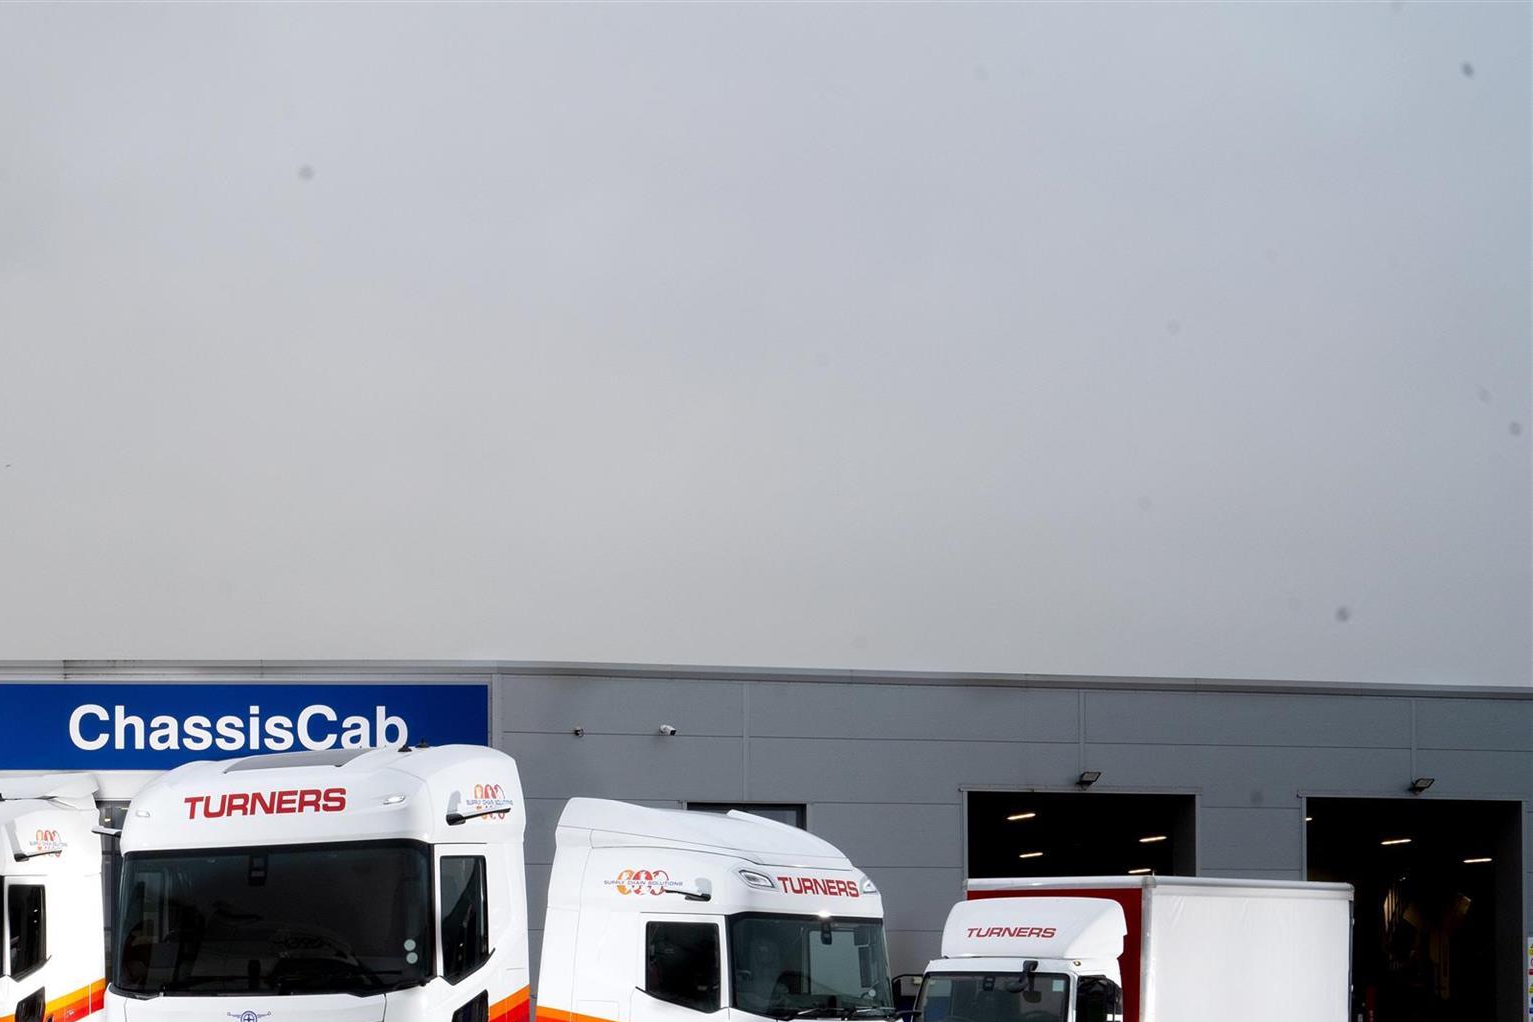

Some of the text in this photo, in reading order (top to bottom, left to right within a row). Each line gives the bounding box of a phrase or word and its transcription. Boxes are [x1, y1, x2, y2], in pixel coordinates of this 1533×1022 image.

[68, 704, 409, 751] ChassisCab
[184, 787, 347, 820] TURNERS
[777, 876, 859, 897] TURNERS
[967, 926, 1057, 938] TURNERS
